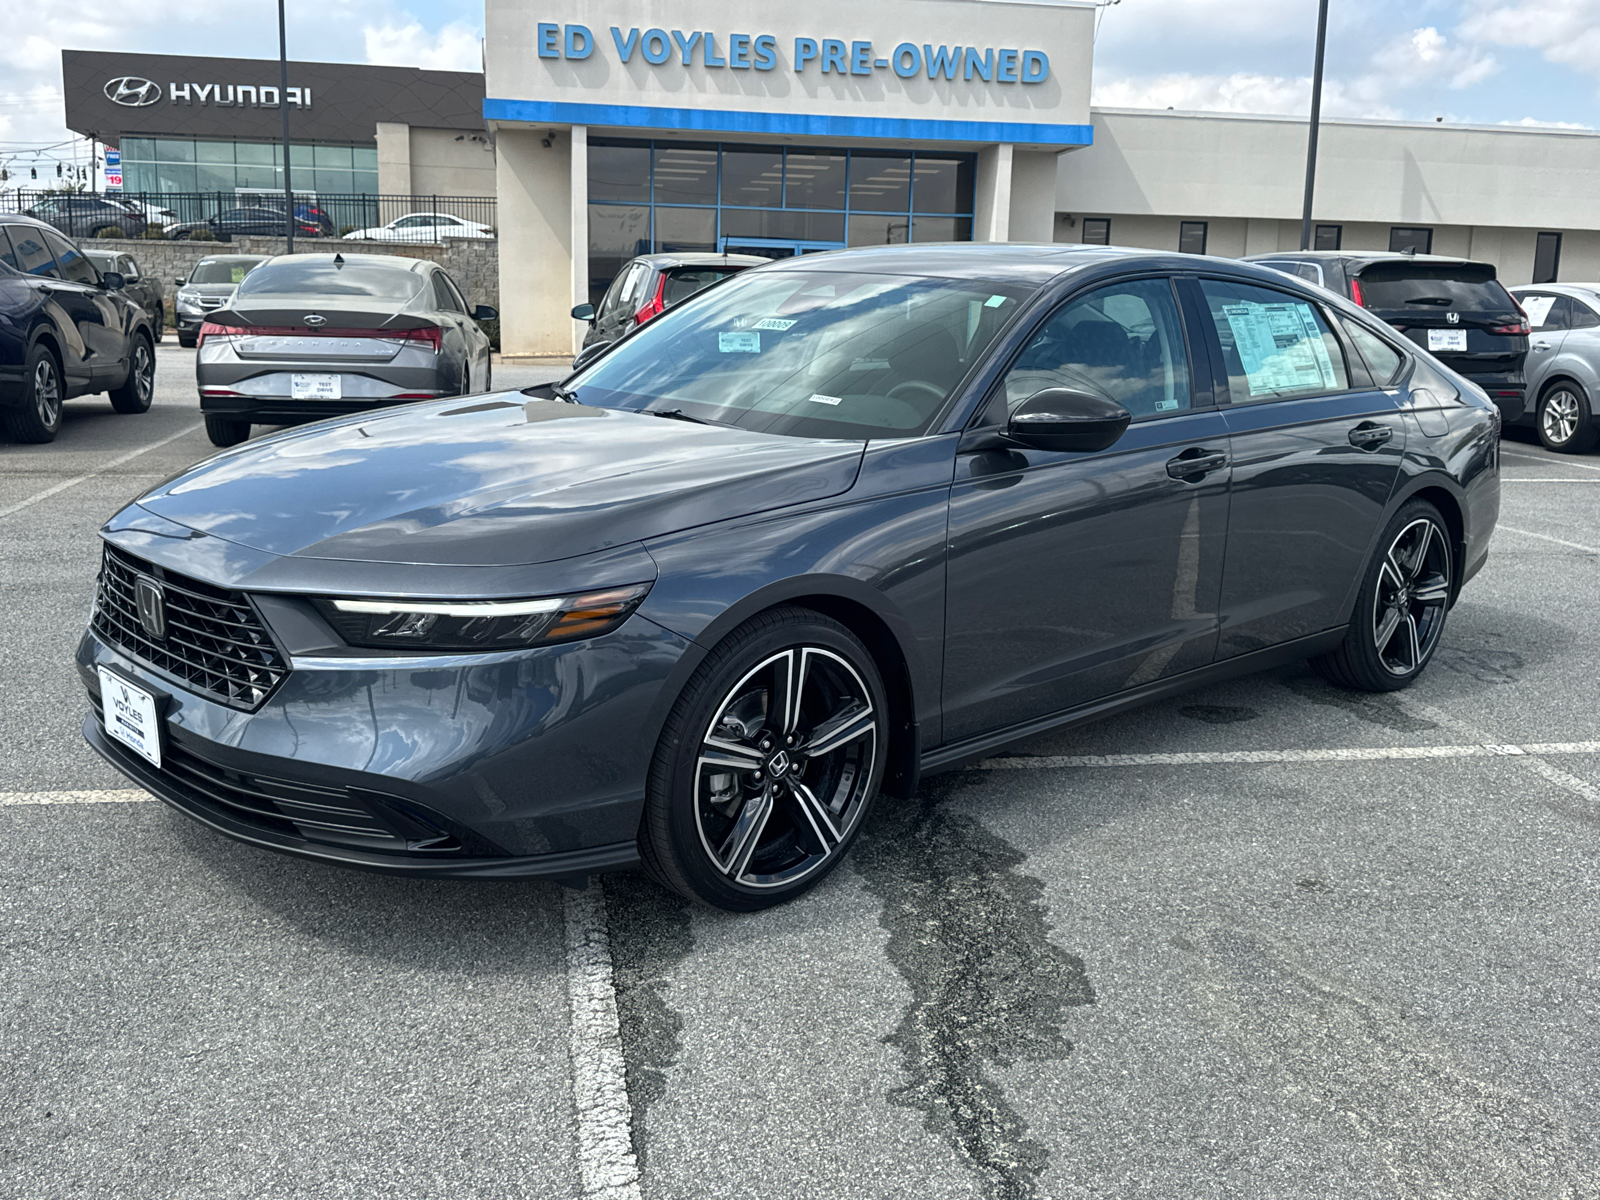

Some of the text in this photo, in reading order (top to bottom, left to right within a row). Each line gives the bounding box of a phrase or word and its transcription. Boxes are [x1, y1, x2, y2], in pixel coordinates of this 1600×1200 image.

[538, 23, 1050, 84] ED VOYLES PRE-OWNED
[169, 82, 311, 109] HYUNDAI
[113, 696, 143, 724] VOYLES
